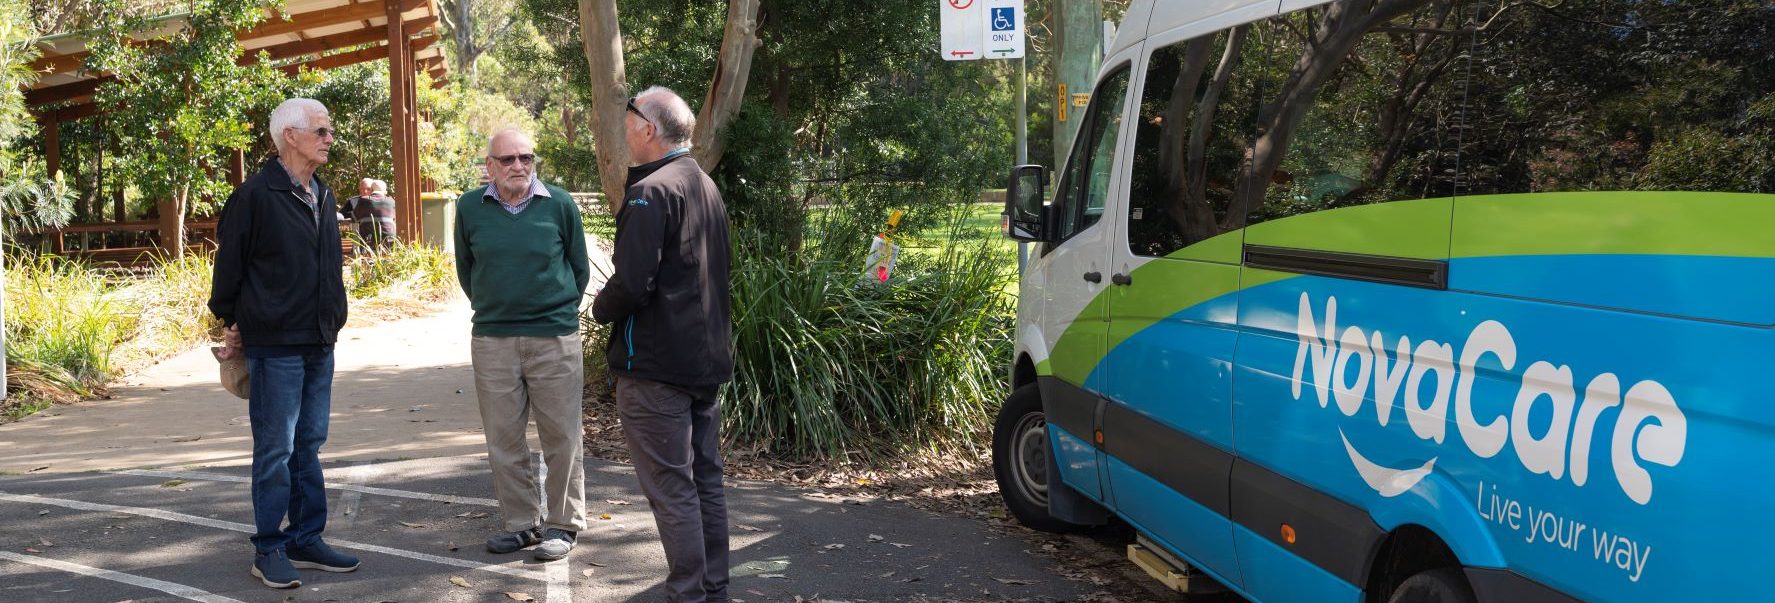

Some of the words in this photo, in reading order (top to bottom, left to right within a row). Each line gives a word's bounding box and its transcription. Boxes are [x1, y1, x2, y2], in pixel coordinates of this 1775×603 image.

[992, 33, 1015, 42] ONLY
[1292, 292, 1687, 505] NovaCare
[1477, 481, 1522, 530] Live
[1526, 505, 1587, 552] your
[1592, 527, 1651, 582] way
